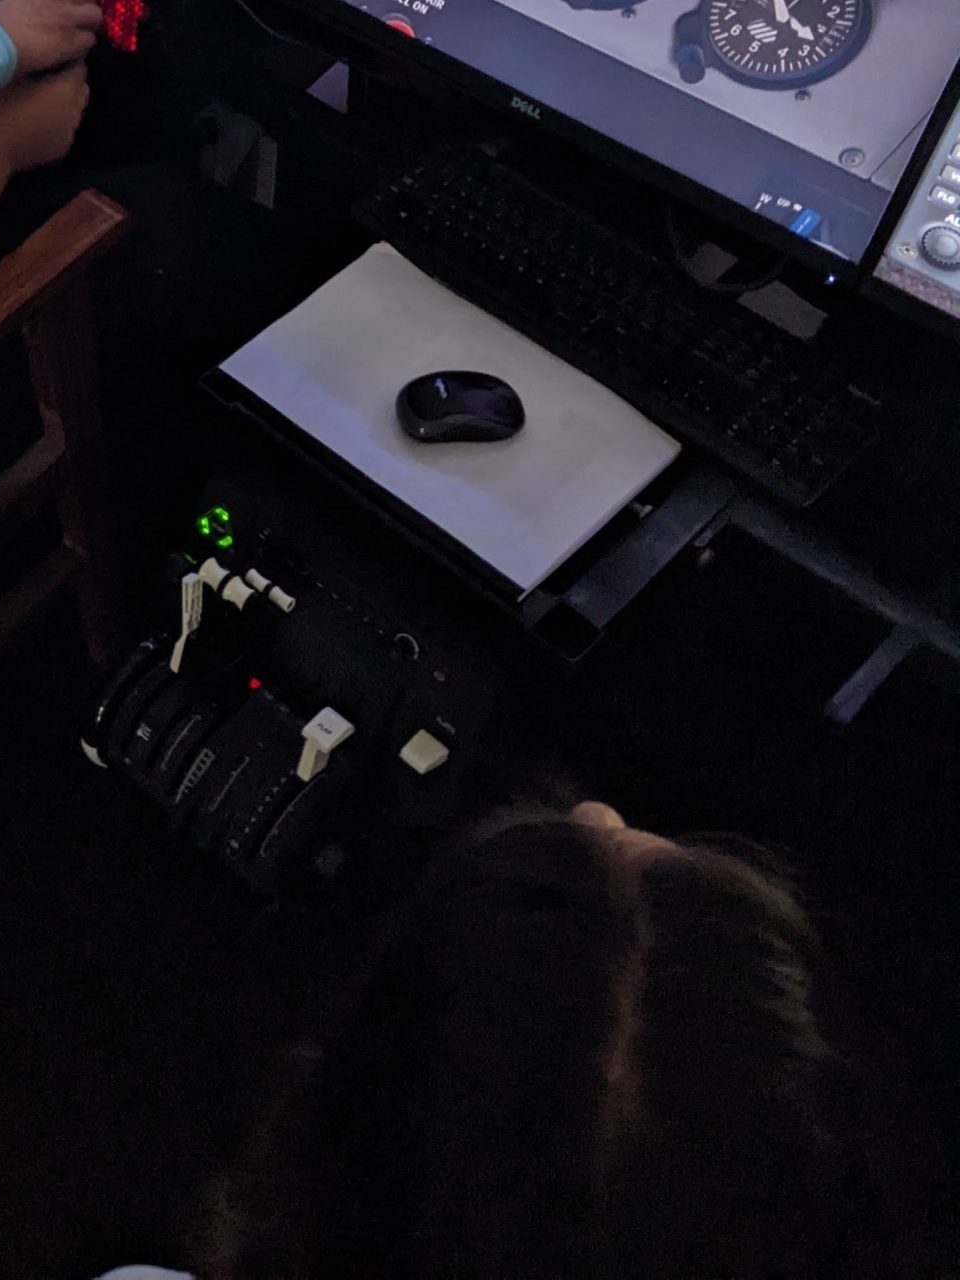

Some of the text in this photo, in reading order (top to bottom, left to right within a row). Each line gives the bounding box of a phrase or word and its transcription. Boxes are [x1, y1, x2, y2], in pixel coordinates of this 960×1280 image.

[412, 0, 429, 15] ON
[827, 6, 840, 19] 2
[724, 9, 737, 21] 7
[730, 25, 742, 36] 6
[749, 41, 761, 52] 5
[777, 47, 789, 58] 4
[798, 45, 810, 56] 3
[511, 96, 540, 119] DELL
[317, 722, 333, 736] FLAP
